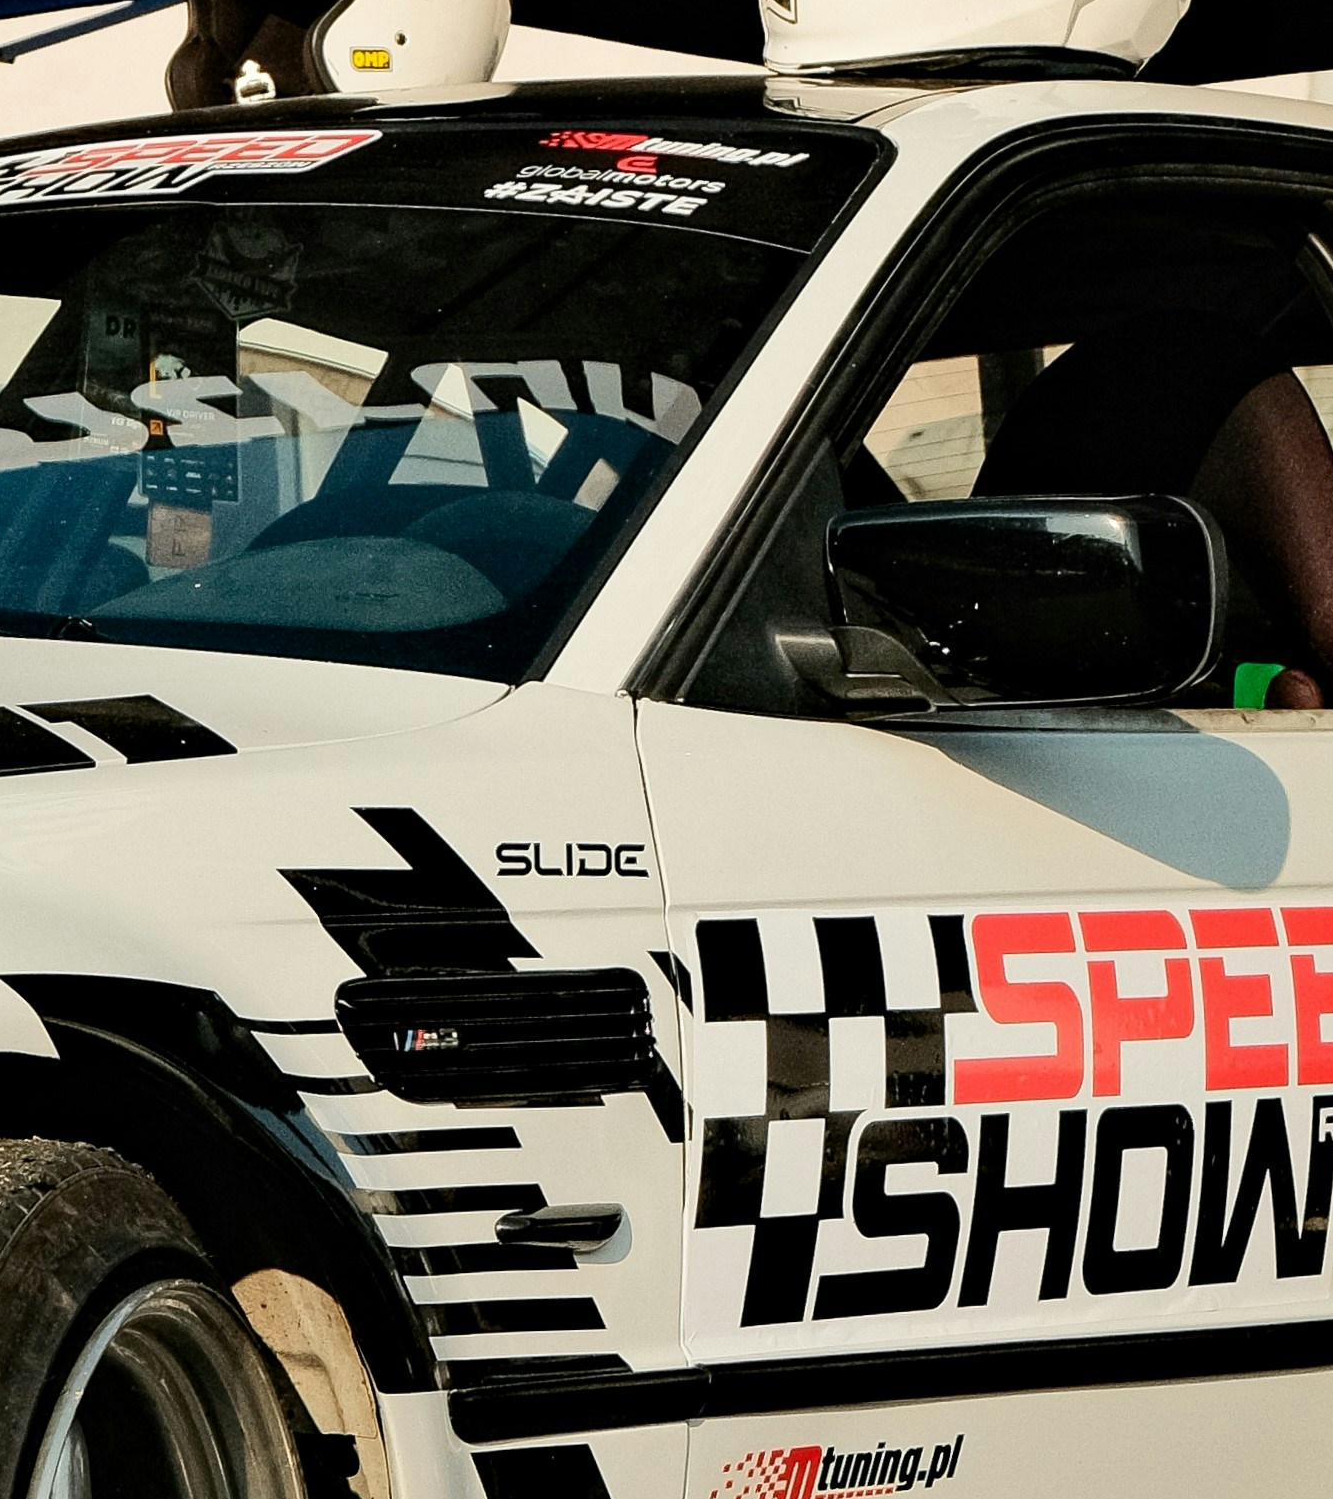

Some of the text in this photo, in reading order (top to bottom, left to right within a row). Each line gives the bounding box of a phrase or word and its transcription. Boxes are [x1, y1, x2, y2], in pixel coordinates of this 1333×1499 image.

[353, 49, 388, 69] OMP
[21, 134, 374, 177] SPEED
[516, 164, 726, 194] globalmotors
[495, 843, 649, 877] SLIDE
